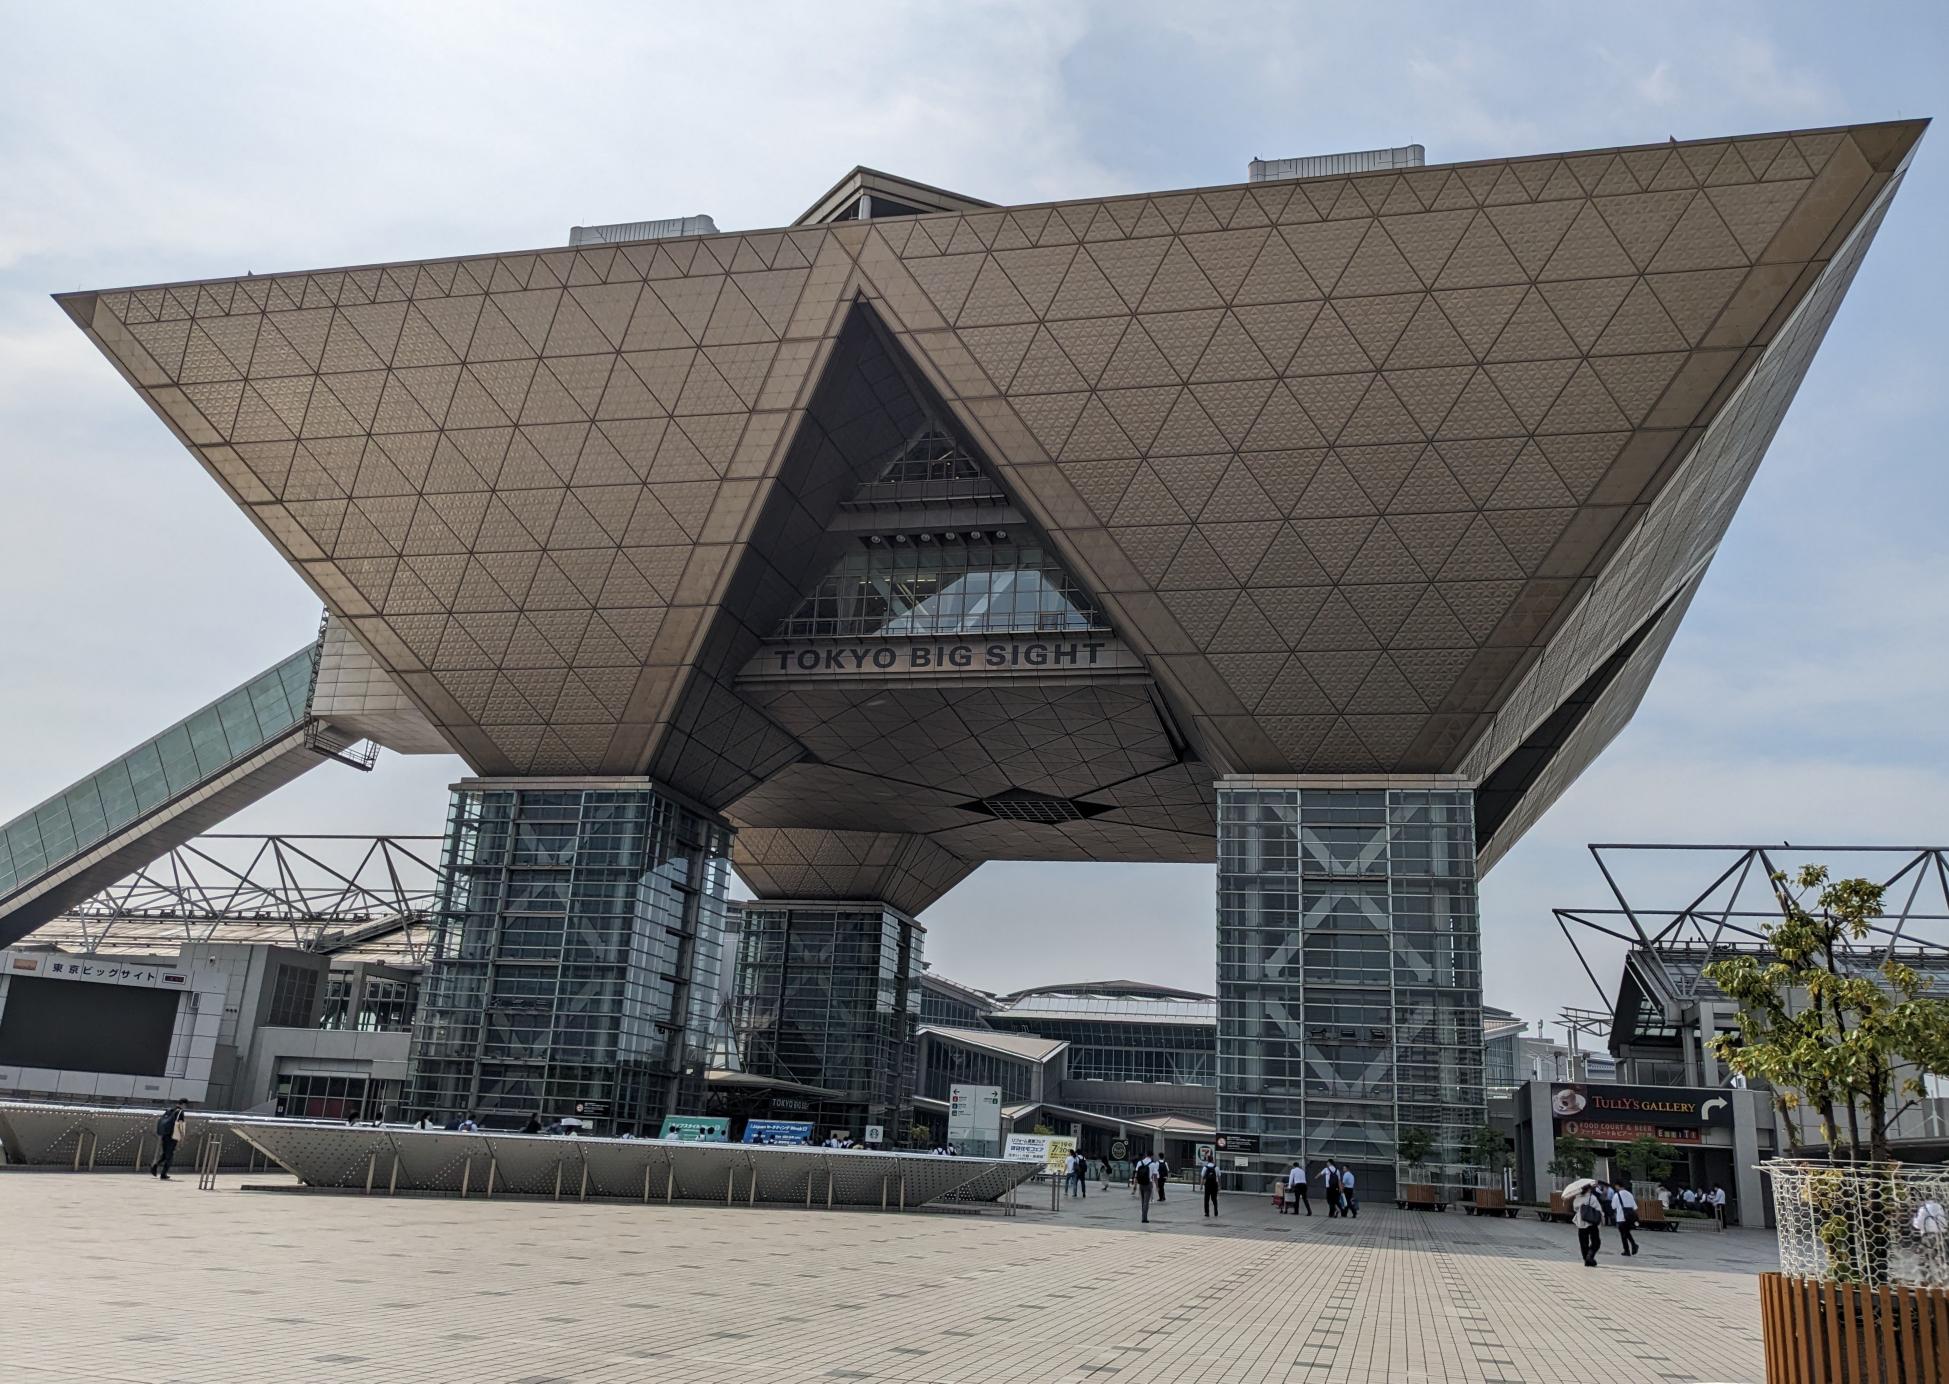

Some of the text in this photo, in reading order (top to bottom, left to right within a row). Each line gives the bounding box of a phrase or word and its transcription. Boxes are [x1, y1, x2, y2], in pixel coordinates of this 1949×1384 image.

[774, 642, 1105, 670] TOKYO BIG SIGHT
[52, 962, 156, 982] 東京ビッグサイト
[772, 1098, 793, 1108] TOKYO
[1592, 1095, 1696, 1113] TULLY'S GALLERY
[1601, 1123, 1624, 1131] COURT
